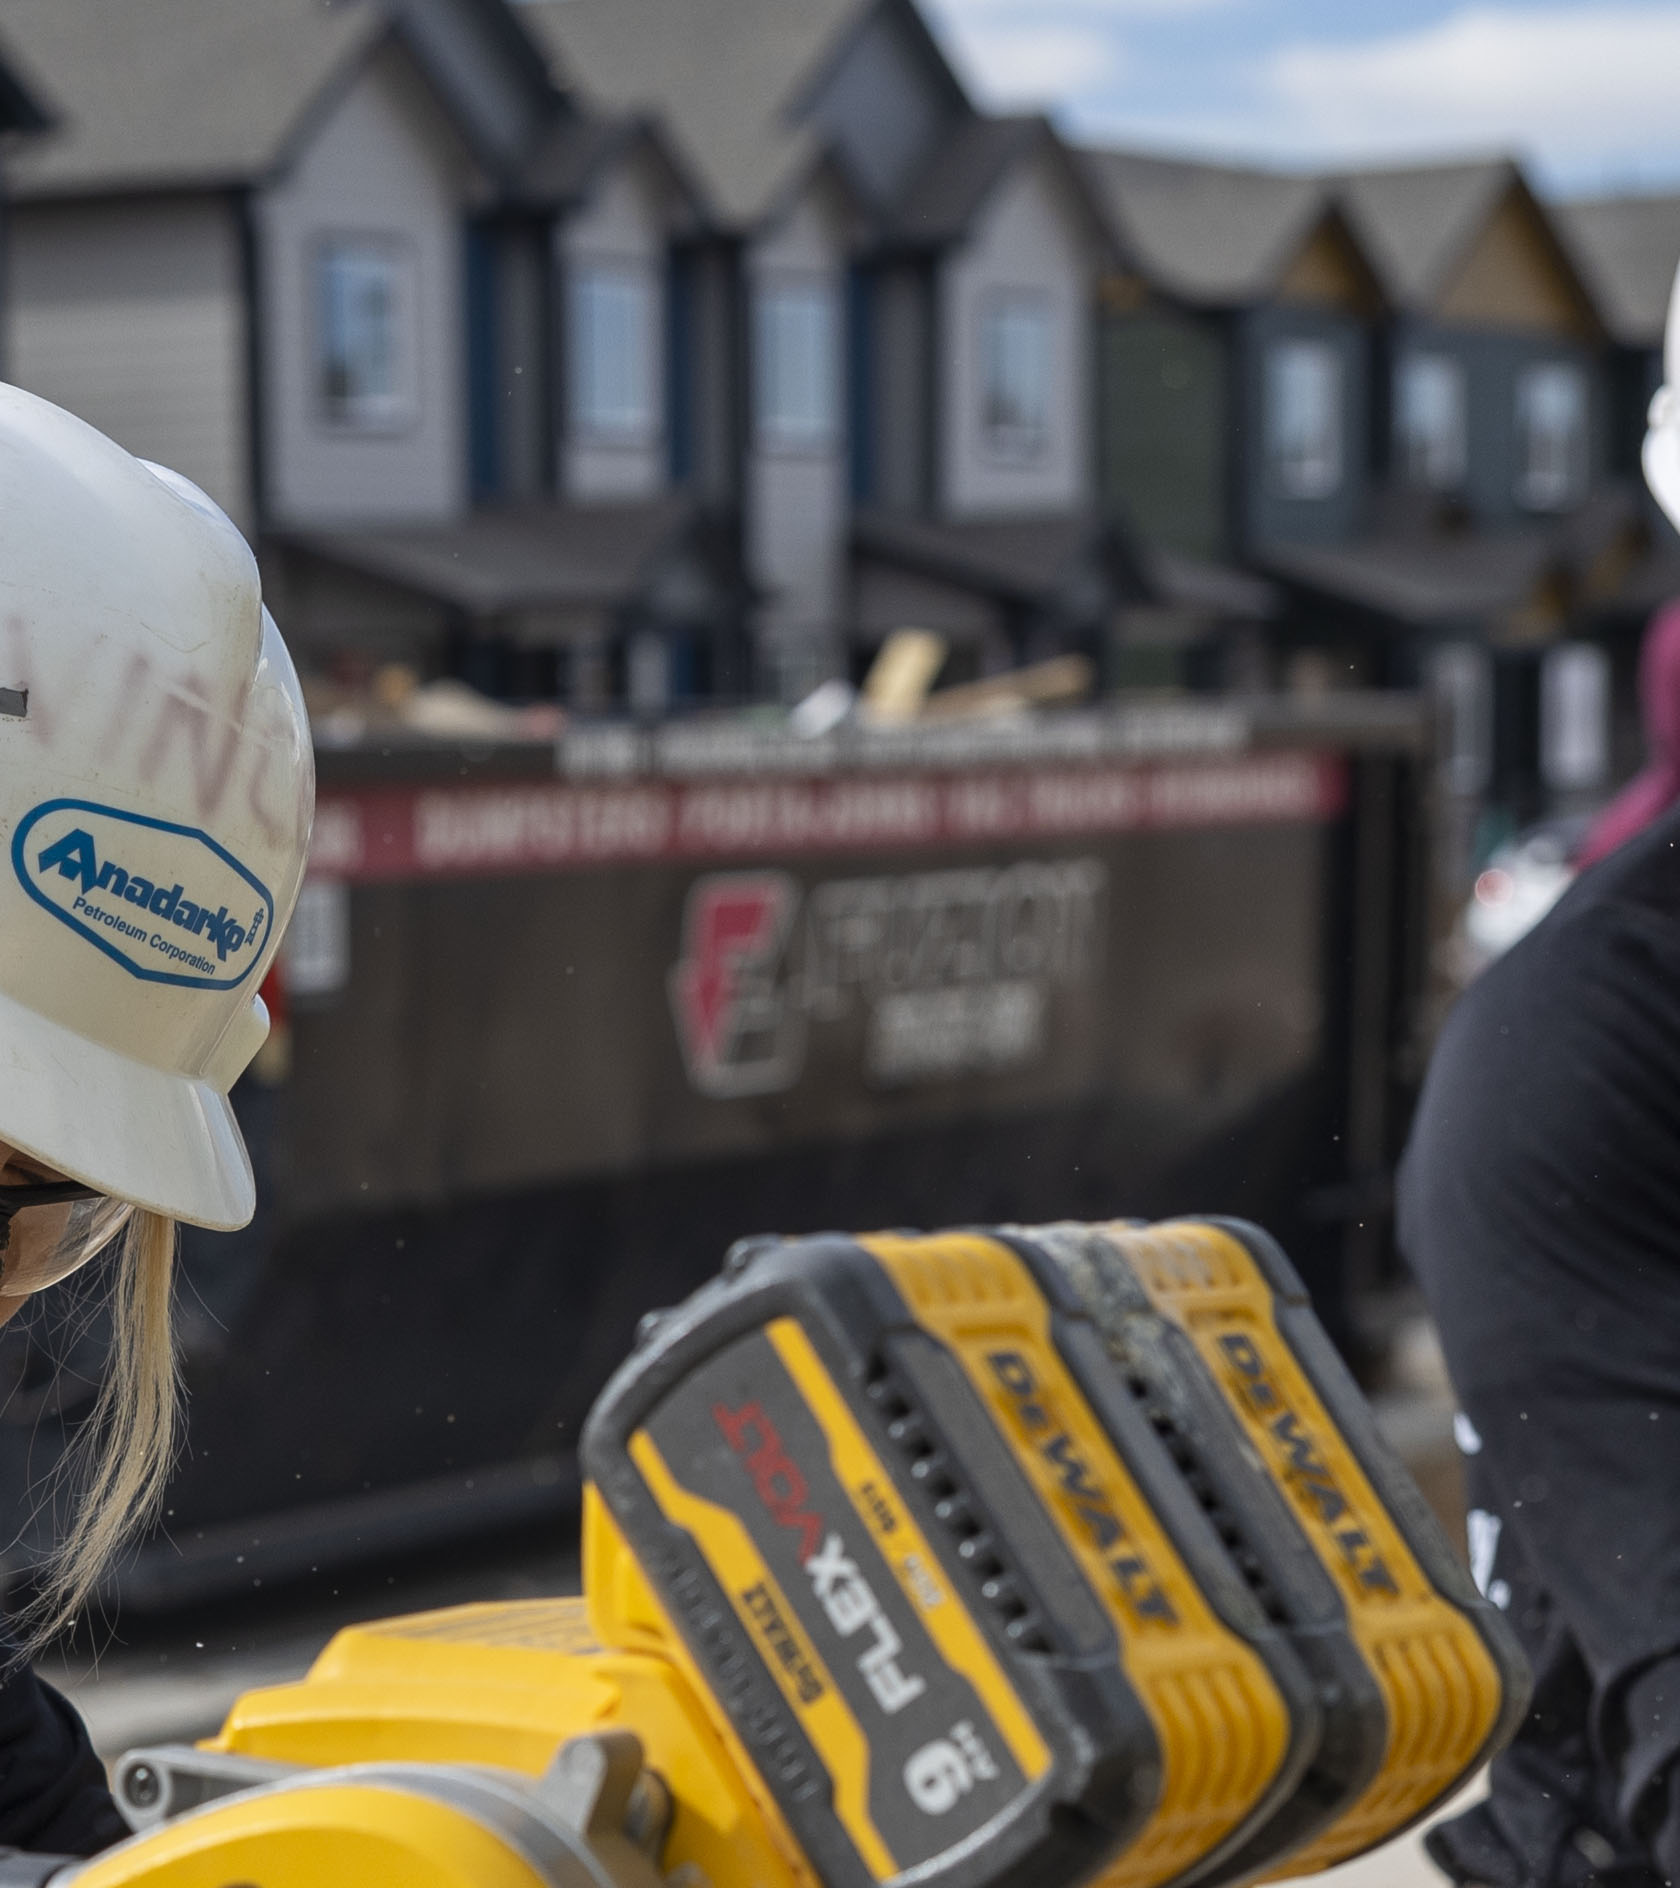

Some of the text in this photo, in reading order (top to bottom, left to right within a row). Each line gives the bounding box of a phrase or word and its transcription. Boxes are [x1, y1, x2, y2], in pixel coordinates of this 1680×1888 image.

[38, 828, 244, 963] Anadarko
[72, 896, 217, 976] Petroleum Corporation
[903, 1739, 976, 1816] 9
